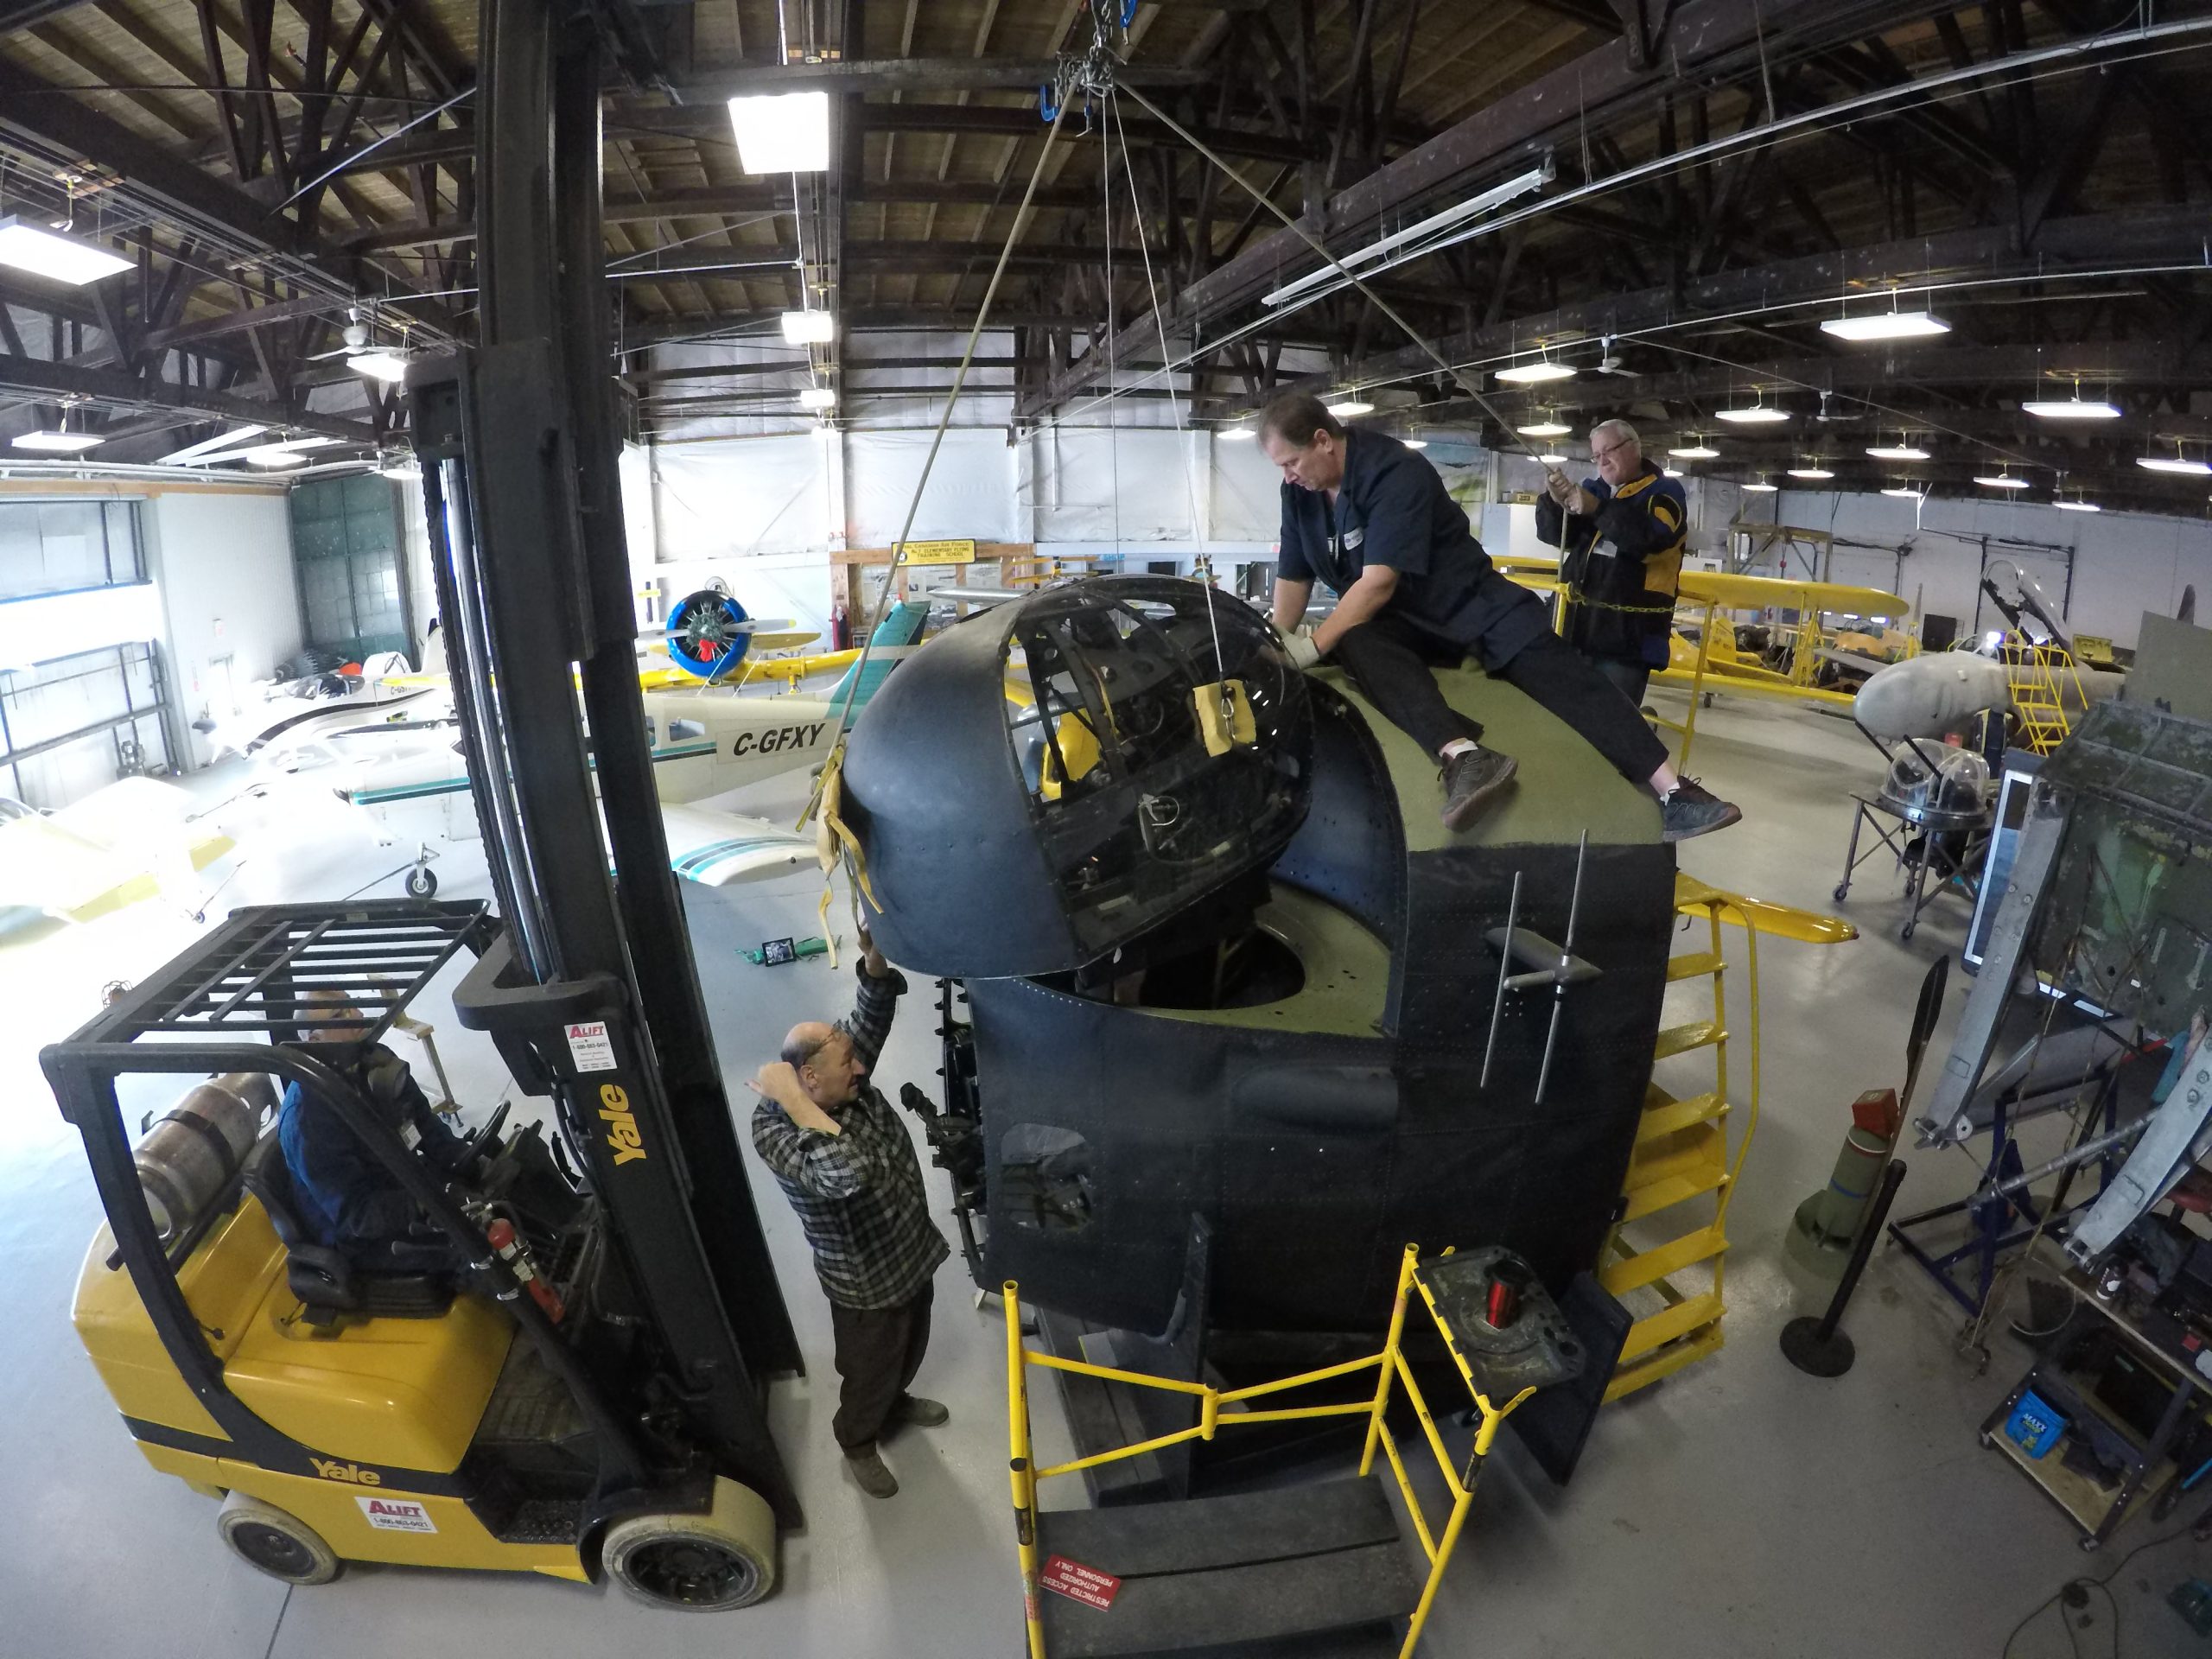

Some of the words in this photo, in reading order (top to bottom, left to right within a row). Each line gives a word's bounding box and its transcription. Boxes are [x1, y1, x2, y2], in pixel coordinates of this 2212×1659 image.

[734, 722, 826, 756] C-GFXY
[599, 1084, 647, 1166] Yale
[309, 1457, 381, 1485] Yale
[1055, 1560, 1073, 1572] ONLY
[1042, 1576, 1069, 1591] ACCESS
[1059, 1573, 1100, 1592] AUTHORIZED
[1077, 1567, 1114, 1587] PERSONNEL
[1071, 1587, 1110, 1607] RESTRICTED
